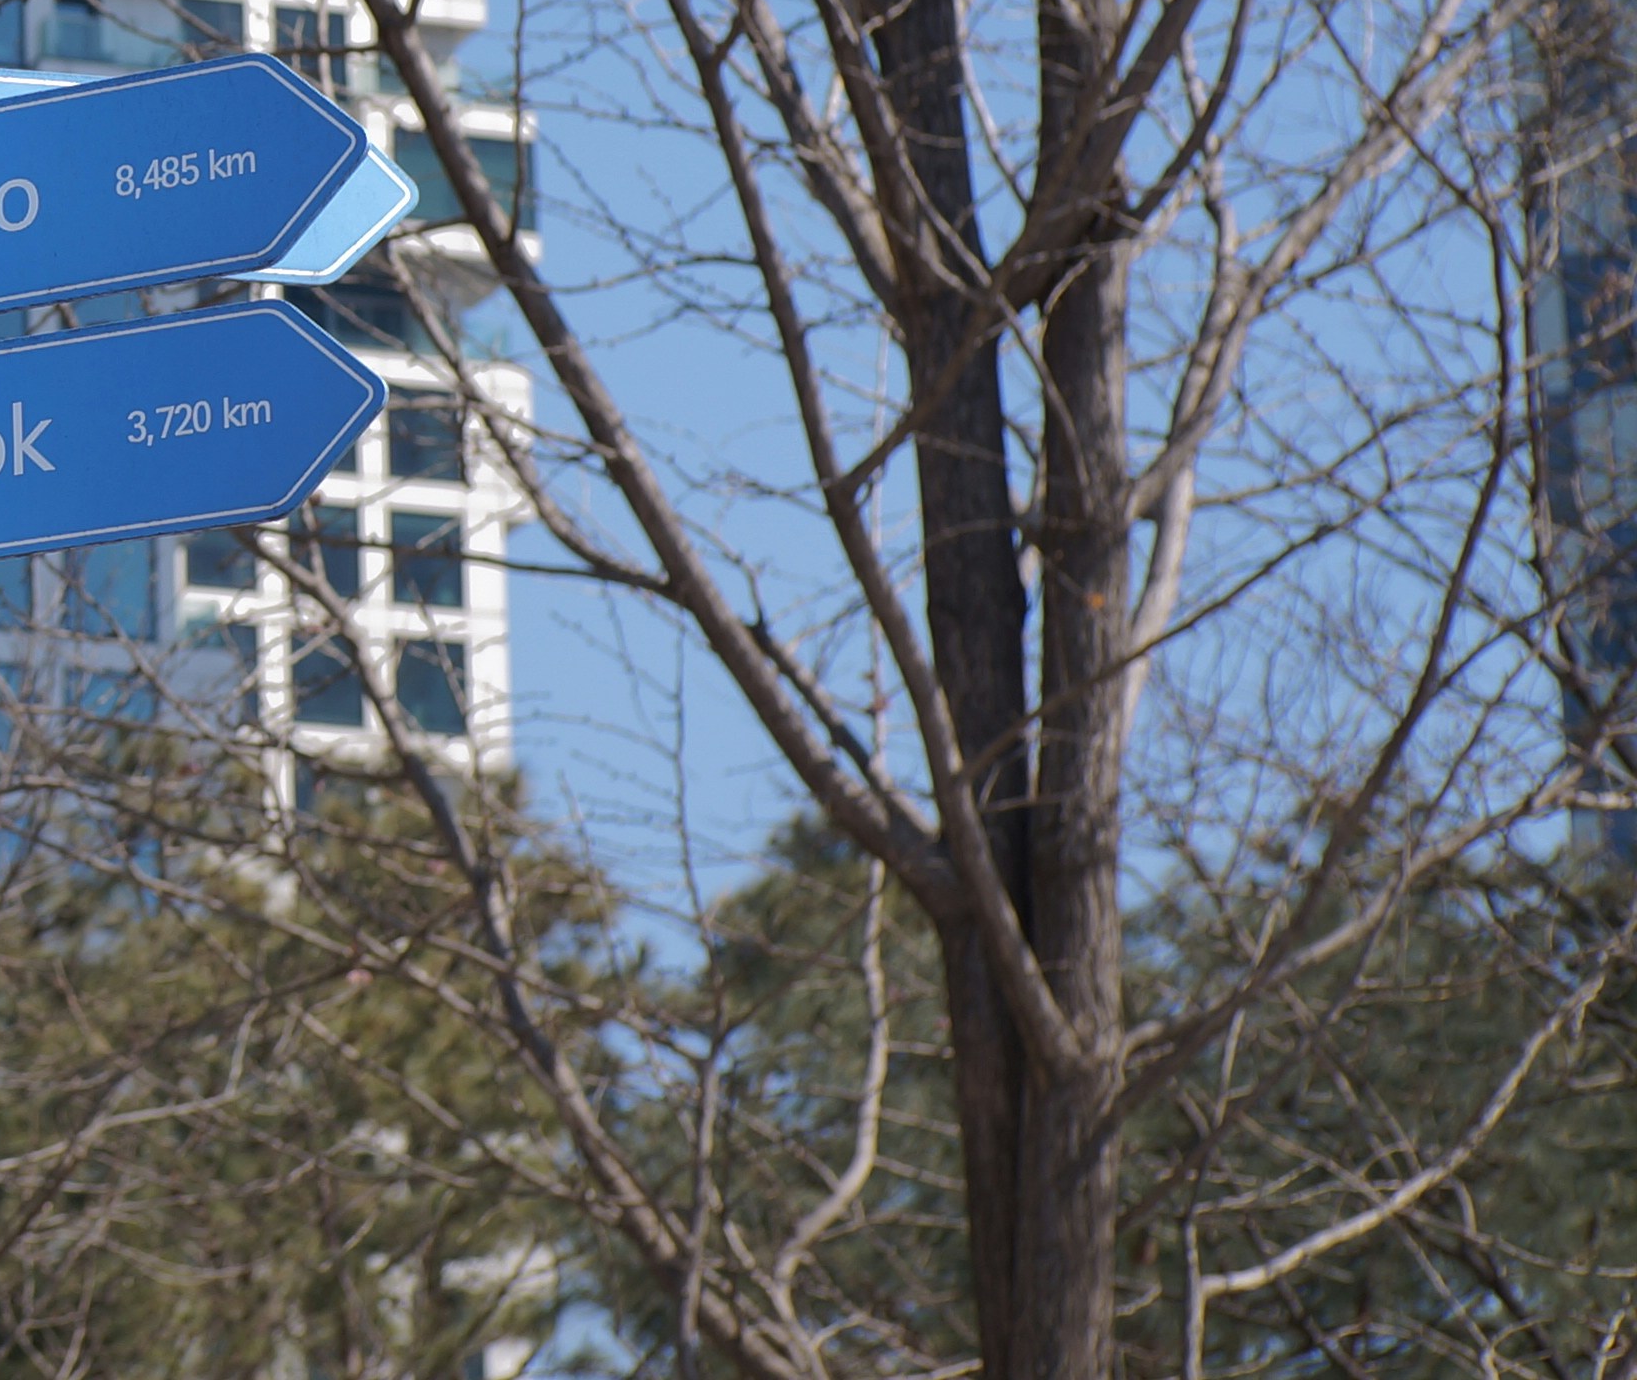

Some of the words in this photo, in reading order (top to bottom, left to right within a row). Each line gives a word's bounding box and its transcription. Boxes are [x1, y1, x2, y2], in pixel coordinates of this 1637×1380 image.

[115, 152, 199, 200] 8,485
[208, 149, 256, 181] km
[126, 400, 212, 447] 3,720
[223, 396, 271, 429] km
